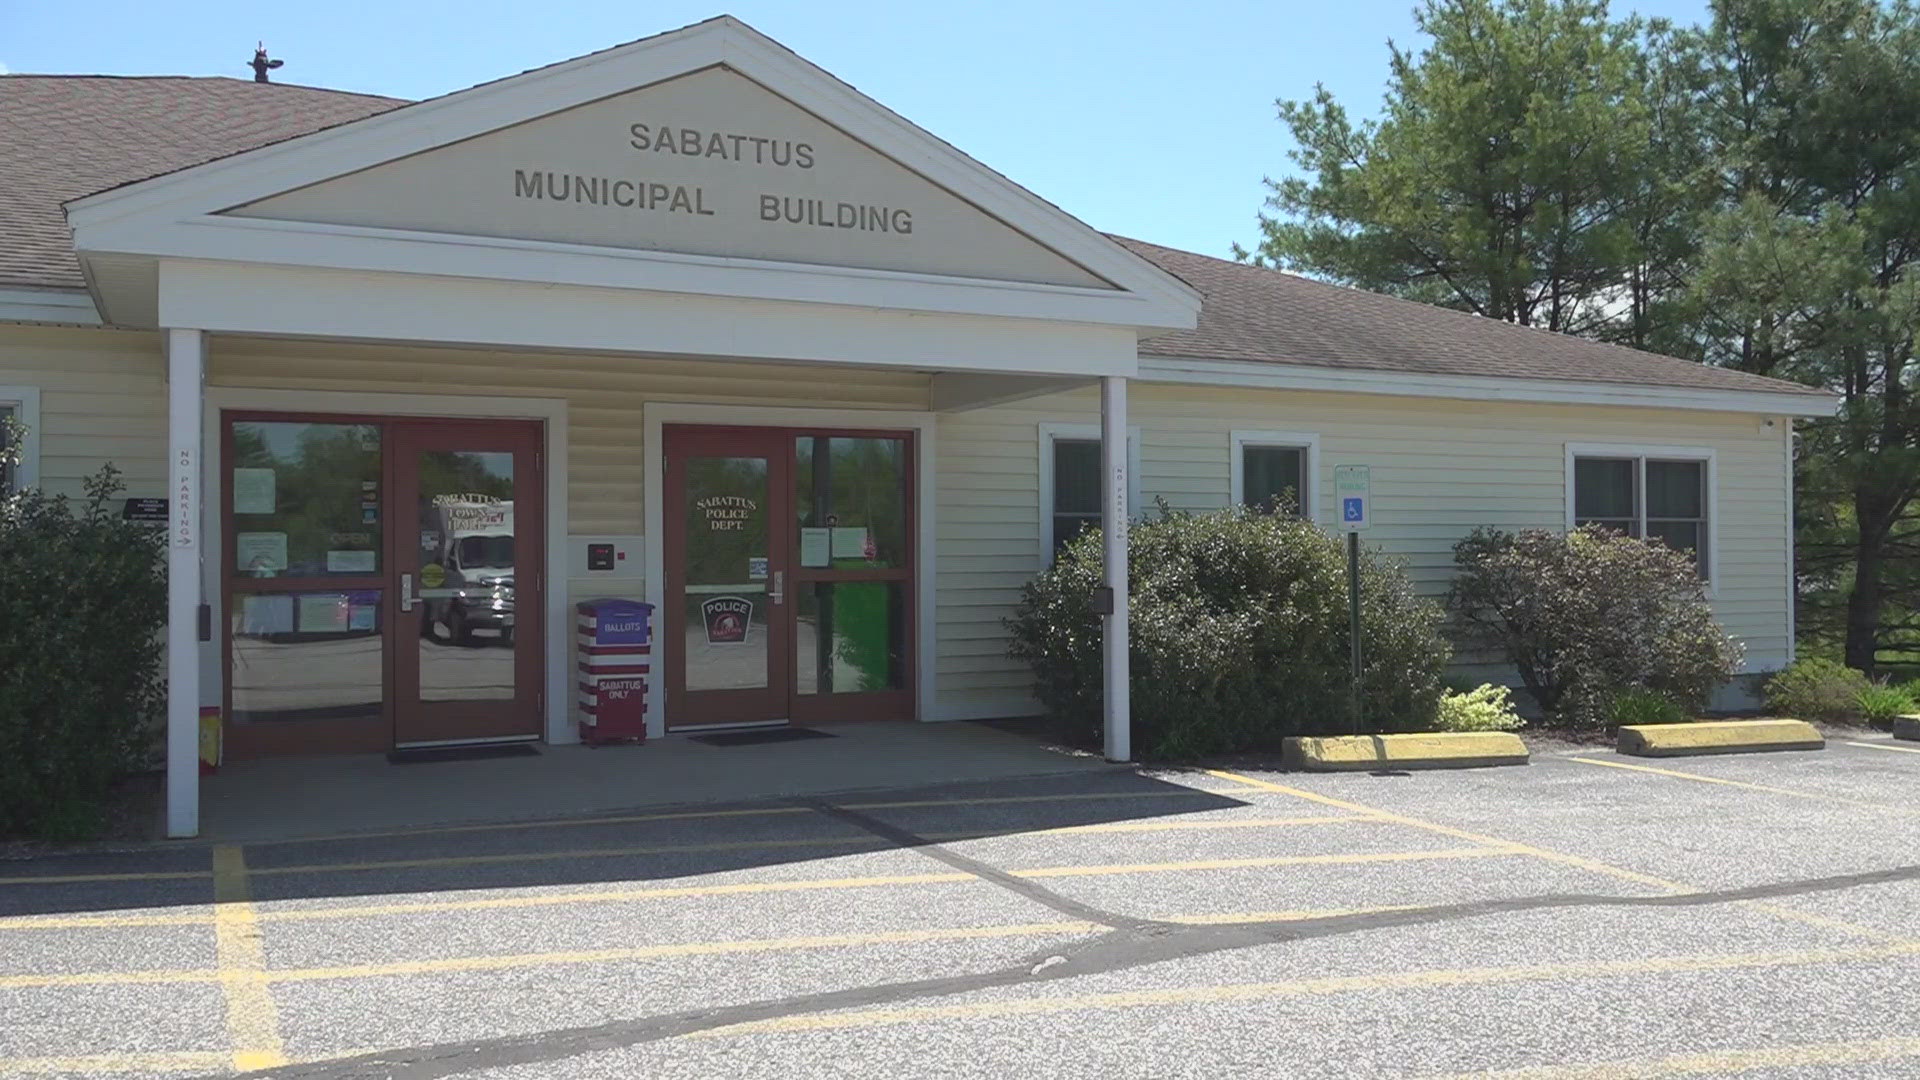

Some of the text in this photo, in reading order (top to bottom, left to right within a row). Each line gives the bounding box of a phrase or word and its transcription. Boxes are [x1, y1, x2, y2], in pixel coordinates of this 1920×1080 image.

[629, 122, 815, 170] SABATTUS
[514, 169, 913, 235] MUNICIPAL BUILDING
[179, 450, 190, 536] NO PARKING
[431, 493, 501, 508] SABATTUS
[1116, 468, 1124, 532] NO PARKING
[696, 495, 757, 511] SABATTUS
[448, 507, 487, 518] TOWN
[705, 509, 749, 519] POLICE
[710, 519, 744, 531] DEPT.
[707, 601, 749, 616] POLICE
[604, 622, 641, 633] BALLOTS
[599, 680, 641, 692] SABATTUS
[608, 690, 630, 700] ONLY
